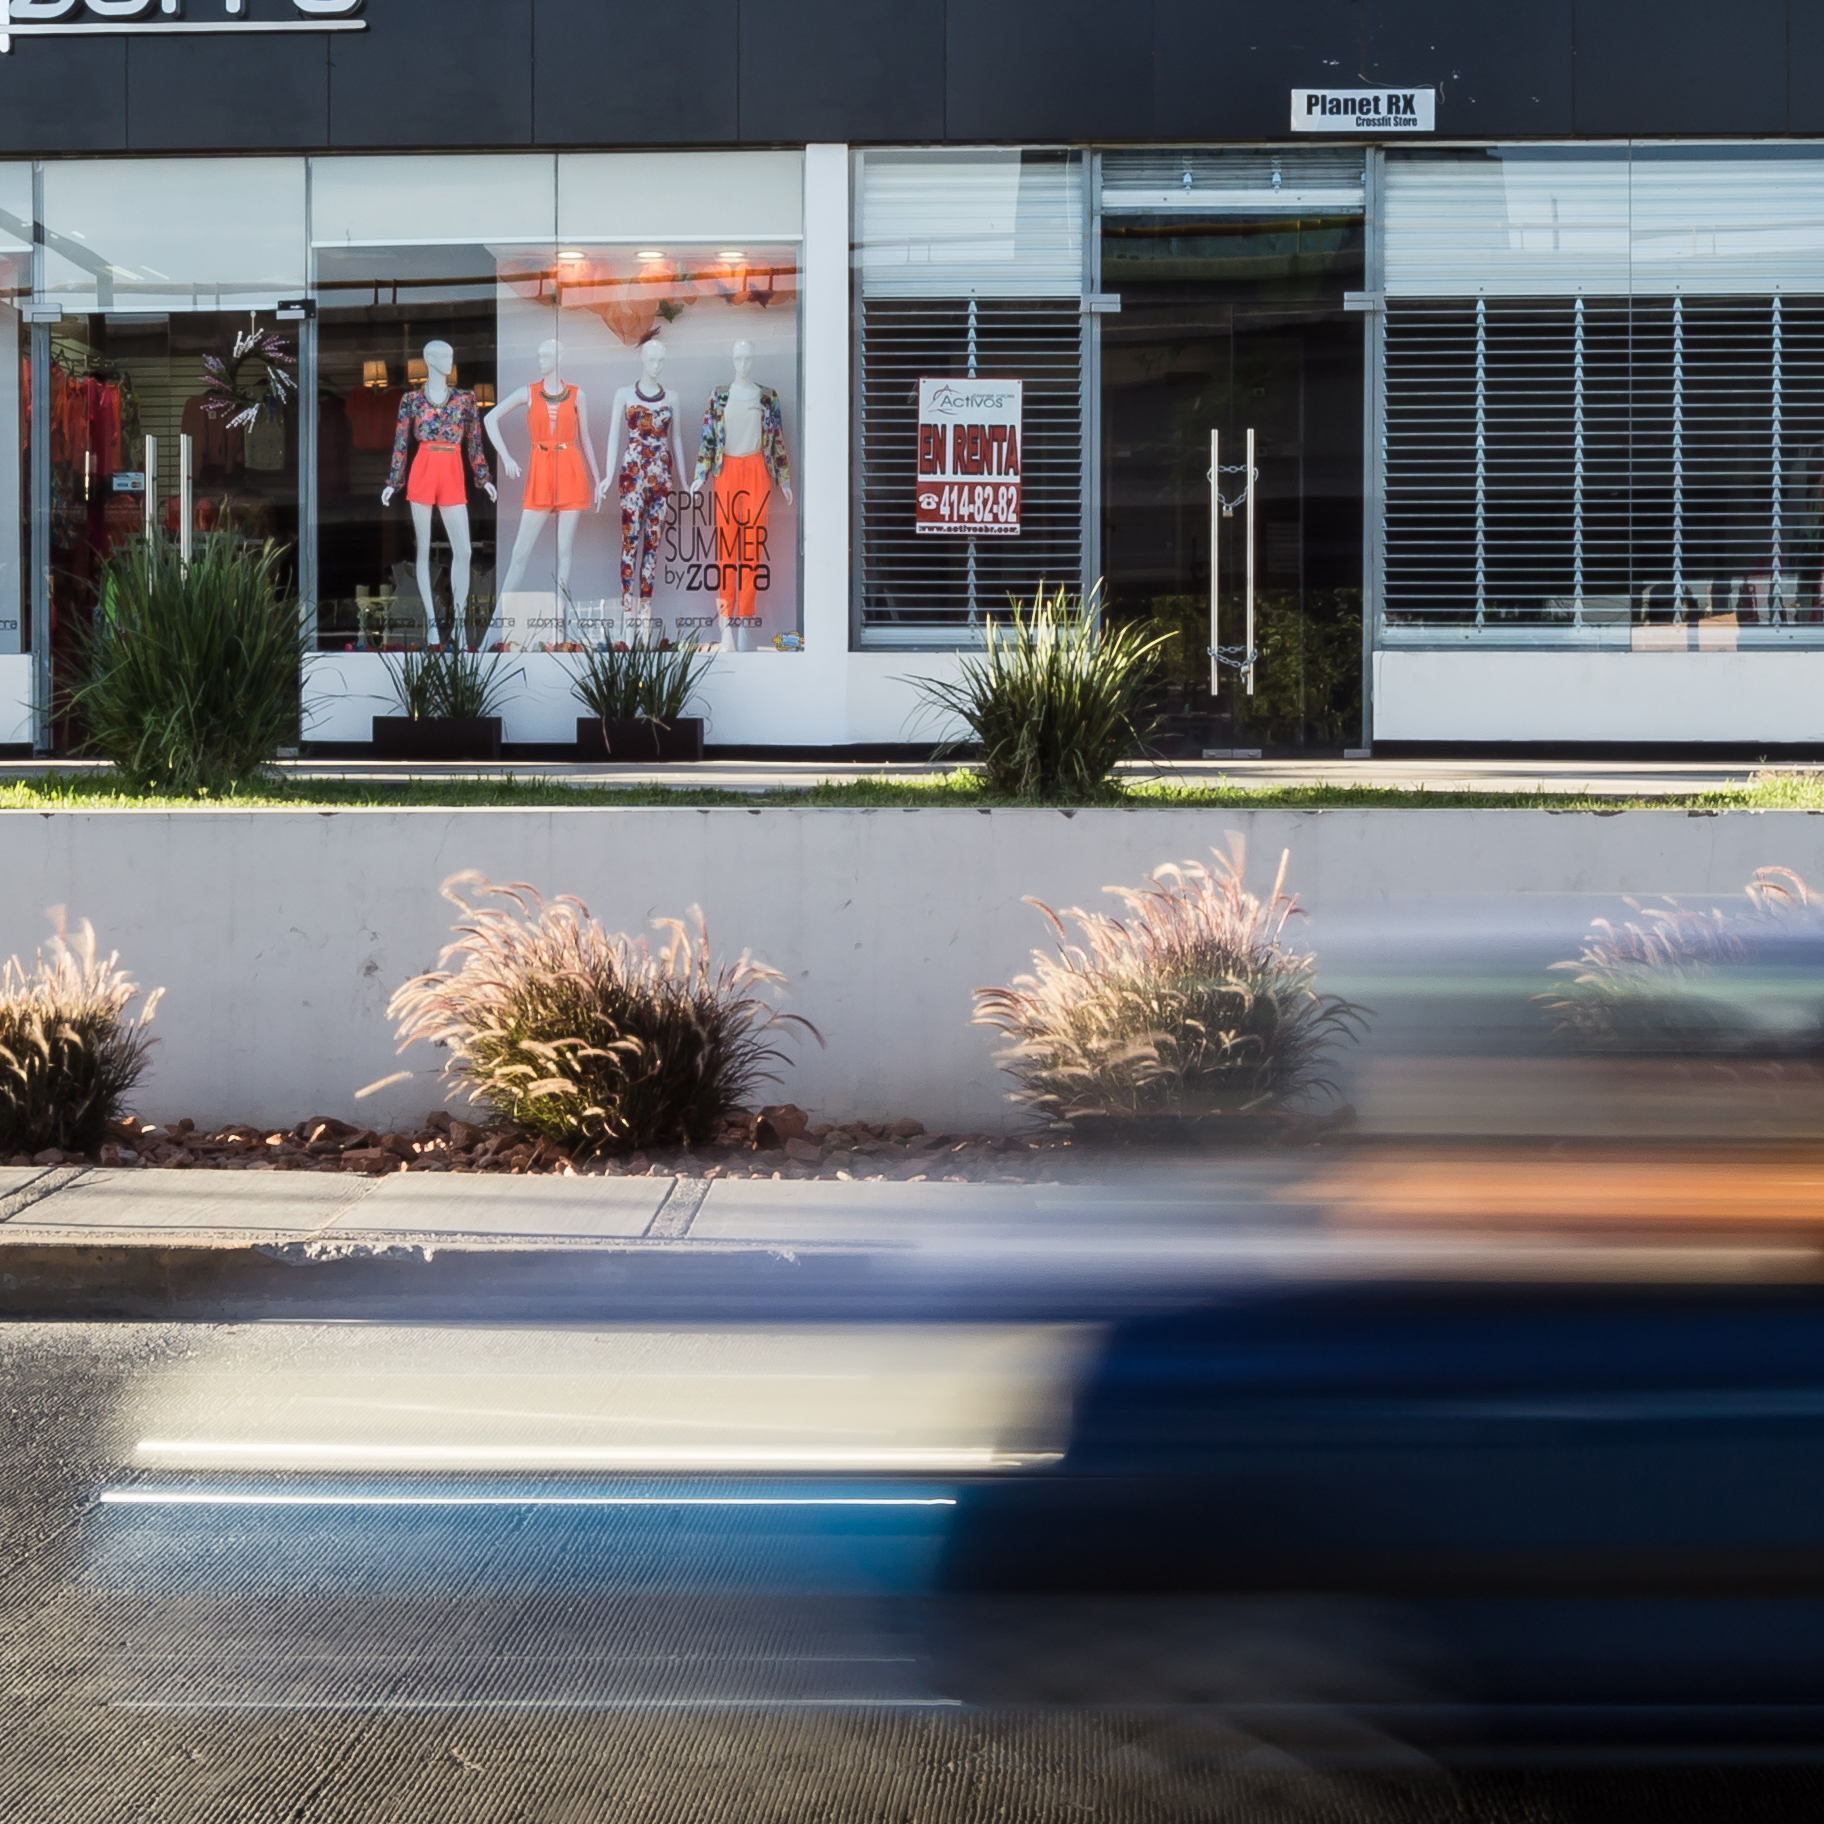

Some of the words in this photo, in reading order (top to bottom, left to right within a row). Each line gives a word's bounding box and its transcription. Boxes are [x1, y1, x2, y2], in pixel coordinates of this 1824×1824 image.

[1306, 94, 1381, 115] Planet
[1387, 94, 1416, 115] RX
[1356, 116, 1392, 127] Crossfit
[1393, 116, 1417, 127] Store
[940, 395, 1003, 408] Activos
[919, 423, 947, 475] EN
[953, 424, 1020, 476] RENTA
[939, 485, 1018, 522] 414-82-82
[665, 526, 771, 562] SUMMER
[665, 564, 685, 590] by
[686, 564, 771, 591] zorra
